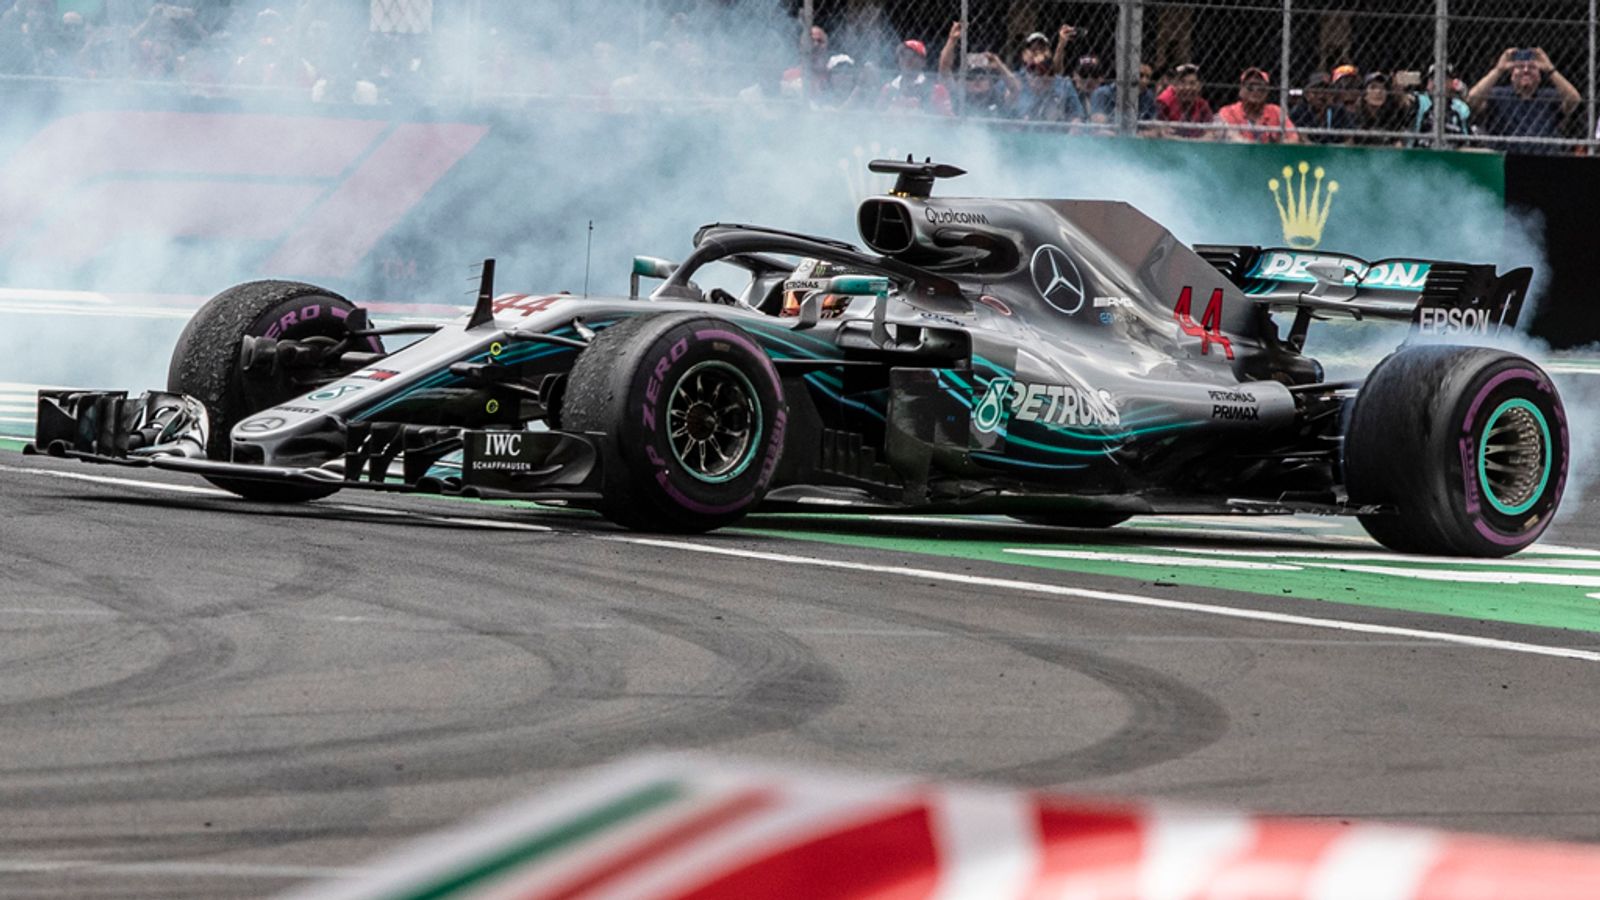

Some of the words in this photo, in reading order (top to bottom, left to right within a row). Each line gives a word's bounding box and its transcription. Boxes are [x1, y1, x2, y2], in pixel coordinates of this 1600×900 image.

[925, 206, 990, 225] Qualcomm
[492, 294, 561, 317] 44
[264, 304, 321, 340] ERO
[1173, 285, 1235, 360] 44
[1420, 307, 1491, 336] EPSON
[642, 337, 689, 432] ZERO
[1010, 381, 1120, 426] PETRONAS
[1207, 390, 1257, 403] PETRONAS
[1211, 404, 1260, 421] PRIMAX
[484, 433, 522, 456] IWC
[472, 461, 531, 470] SCHAFFHAUSEN
